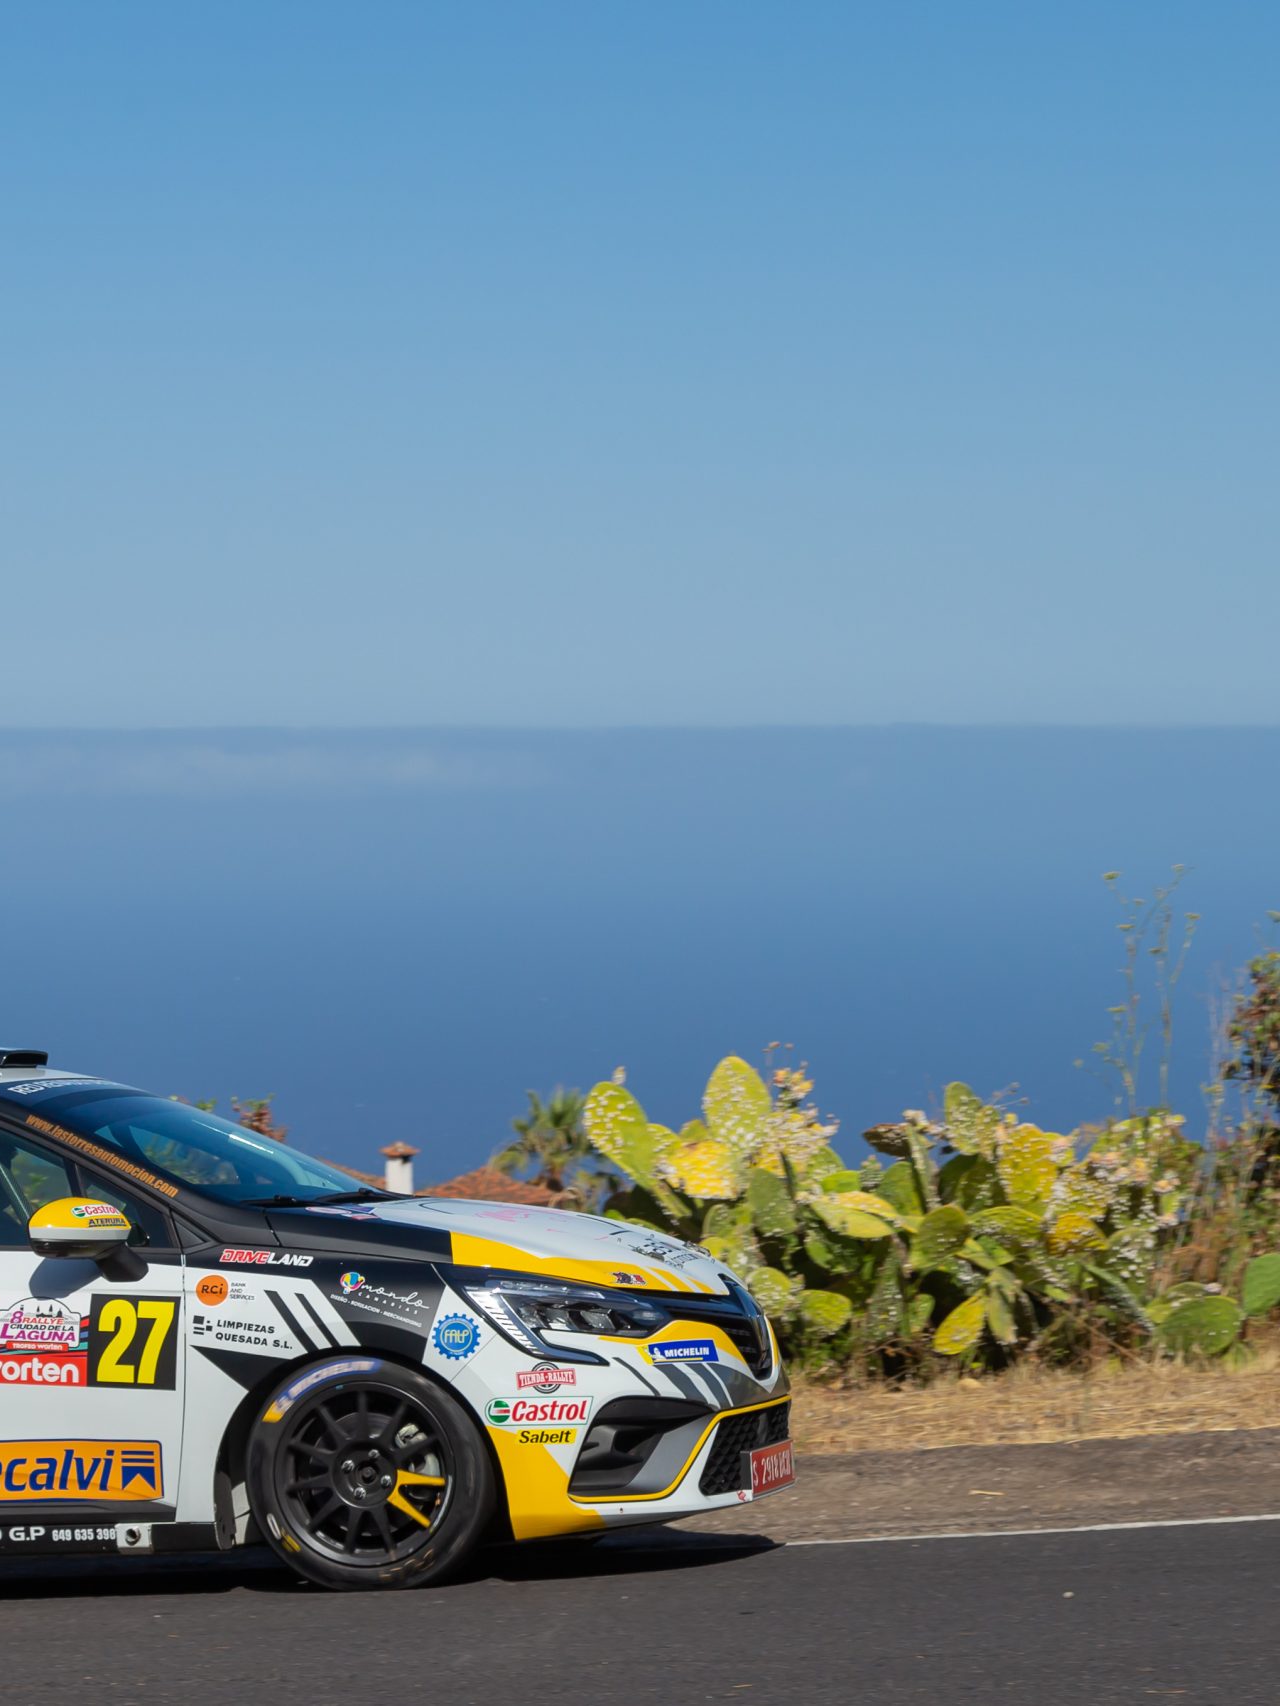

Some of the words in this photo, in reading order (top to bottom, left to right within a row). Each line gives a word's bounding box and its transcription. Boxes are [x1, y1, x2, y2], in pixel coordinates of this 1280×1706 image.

[25, 1114, 180, 1198] www.lastorresautomocion.com
[84, 1205, 120, 1216] Castrol
[220, 1249, 314, 1267] DRIVELAND
[361, 1284, 430, 1309] mondo
[10, 1310, 24, 1325] 8
[22, 1317, 65, 1326] RALLYE
[217, 1319, 275, 1334] LIMPIEZAS
[0, 1323, 76, 1342] LAGUNA
[10, 1323, 48, 1331] CIUDAD
[48, 1324, 61, 1332] DE
[97, 1299, 175, 1384] 27
[215, 1332, 268, 1346] QUESADA
[272, 1340, 293, 1350] S.L.
[664, 1347, 710, 1358] MICHELIN
[519, 1372, 546, 1387] TIENDA
[546, 1370, 574, 1383] RALLYE
[511, 1400, 588, 1422] Castrol
[519, 1430, 572, 1444] Sabelt
[753, 1460, 759, 1487] S
[8, 1526, 46, 1542] G.P
[51, 1528, 72, 1542] 649
[74, 1528, 94, 1541] 635
